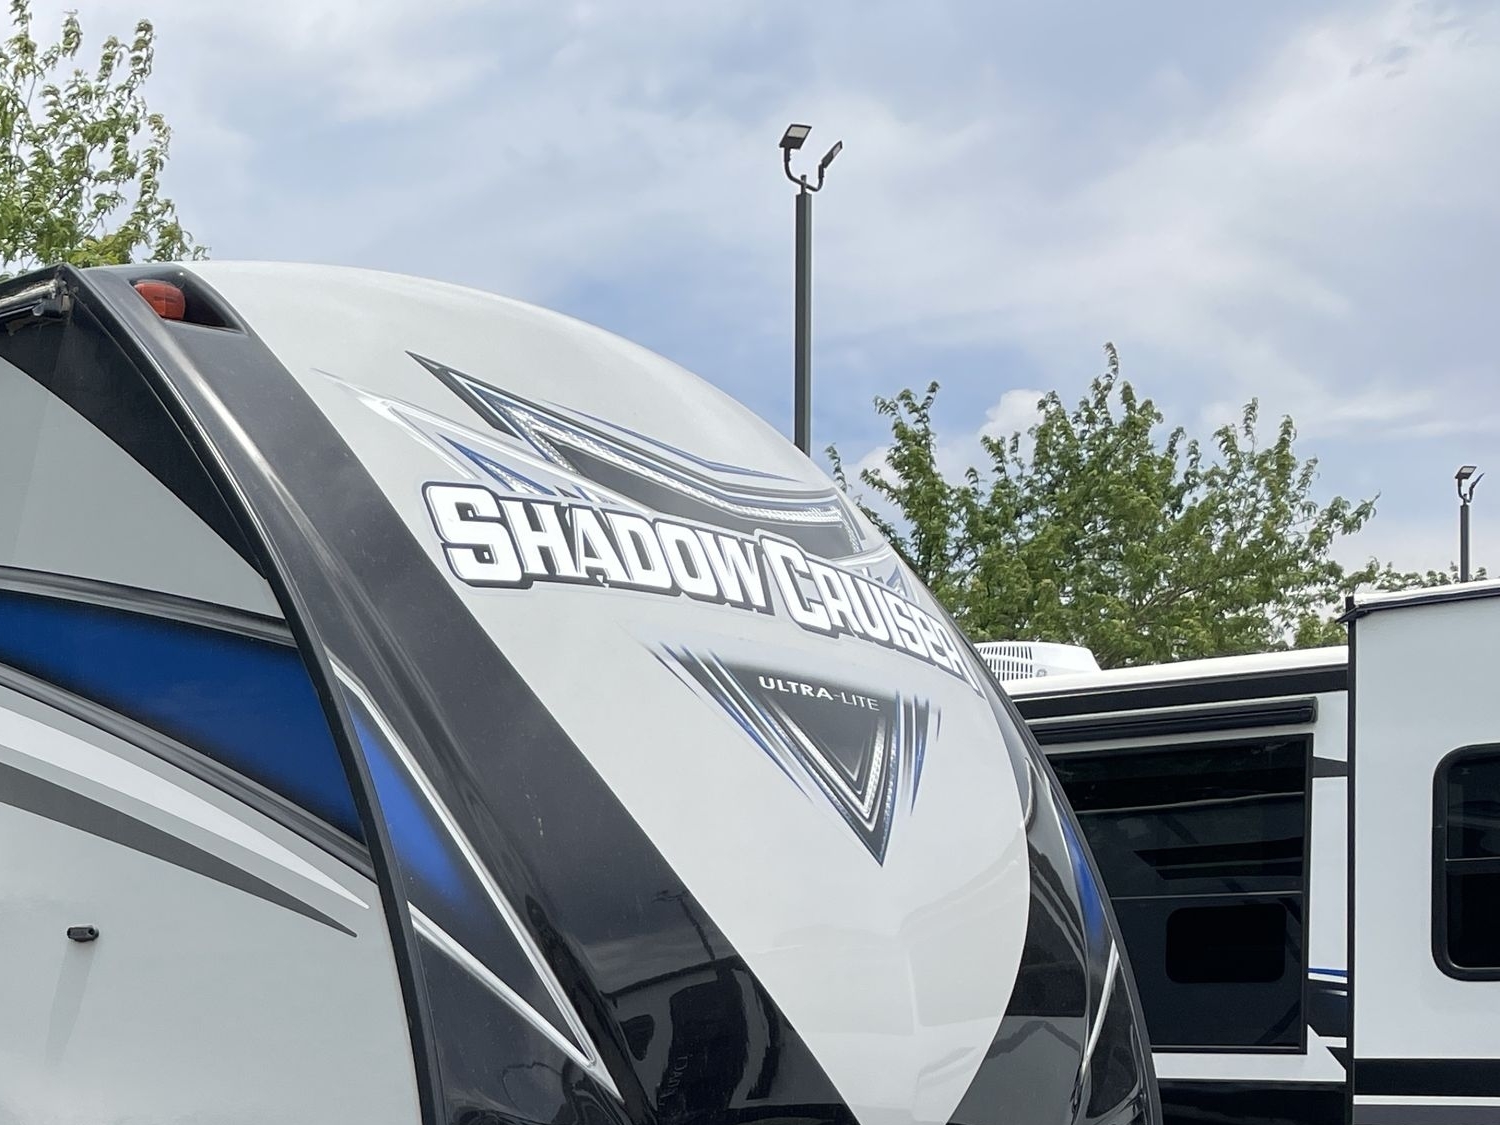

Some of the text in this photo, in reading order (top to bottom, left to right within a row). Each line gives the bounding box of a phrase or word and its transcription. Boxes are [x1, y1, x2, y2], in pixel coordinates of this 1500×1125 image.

[423, 481, 982, 696] SHADOW CRUISER
[759, 675, 880, 712] ULTRA-LITE
